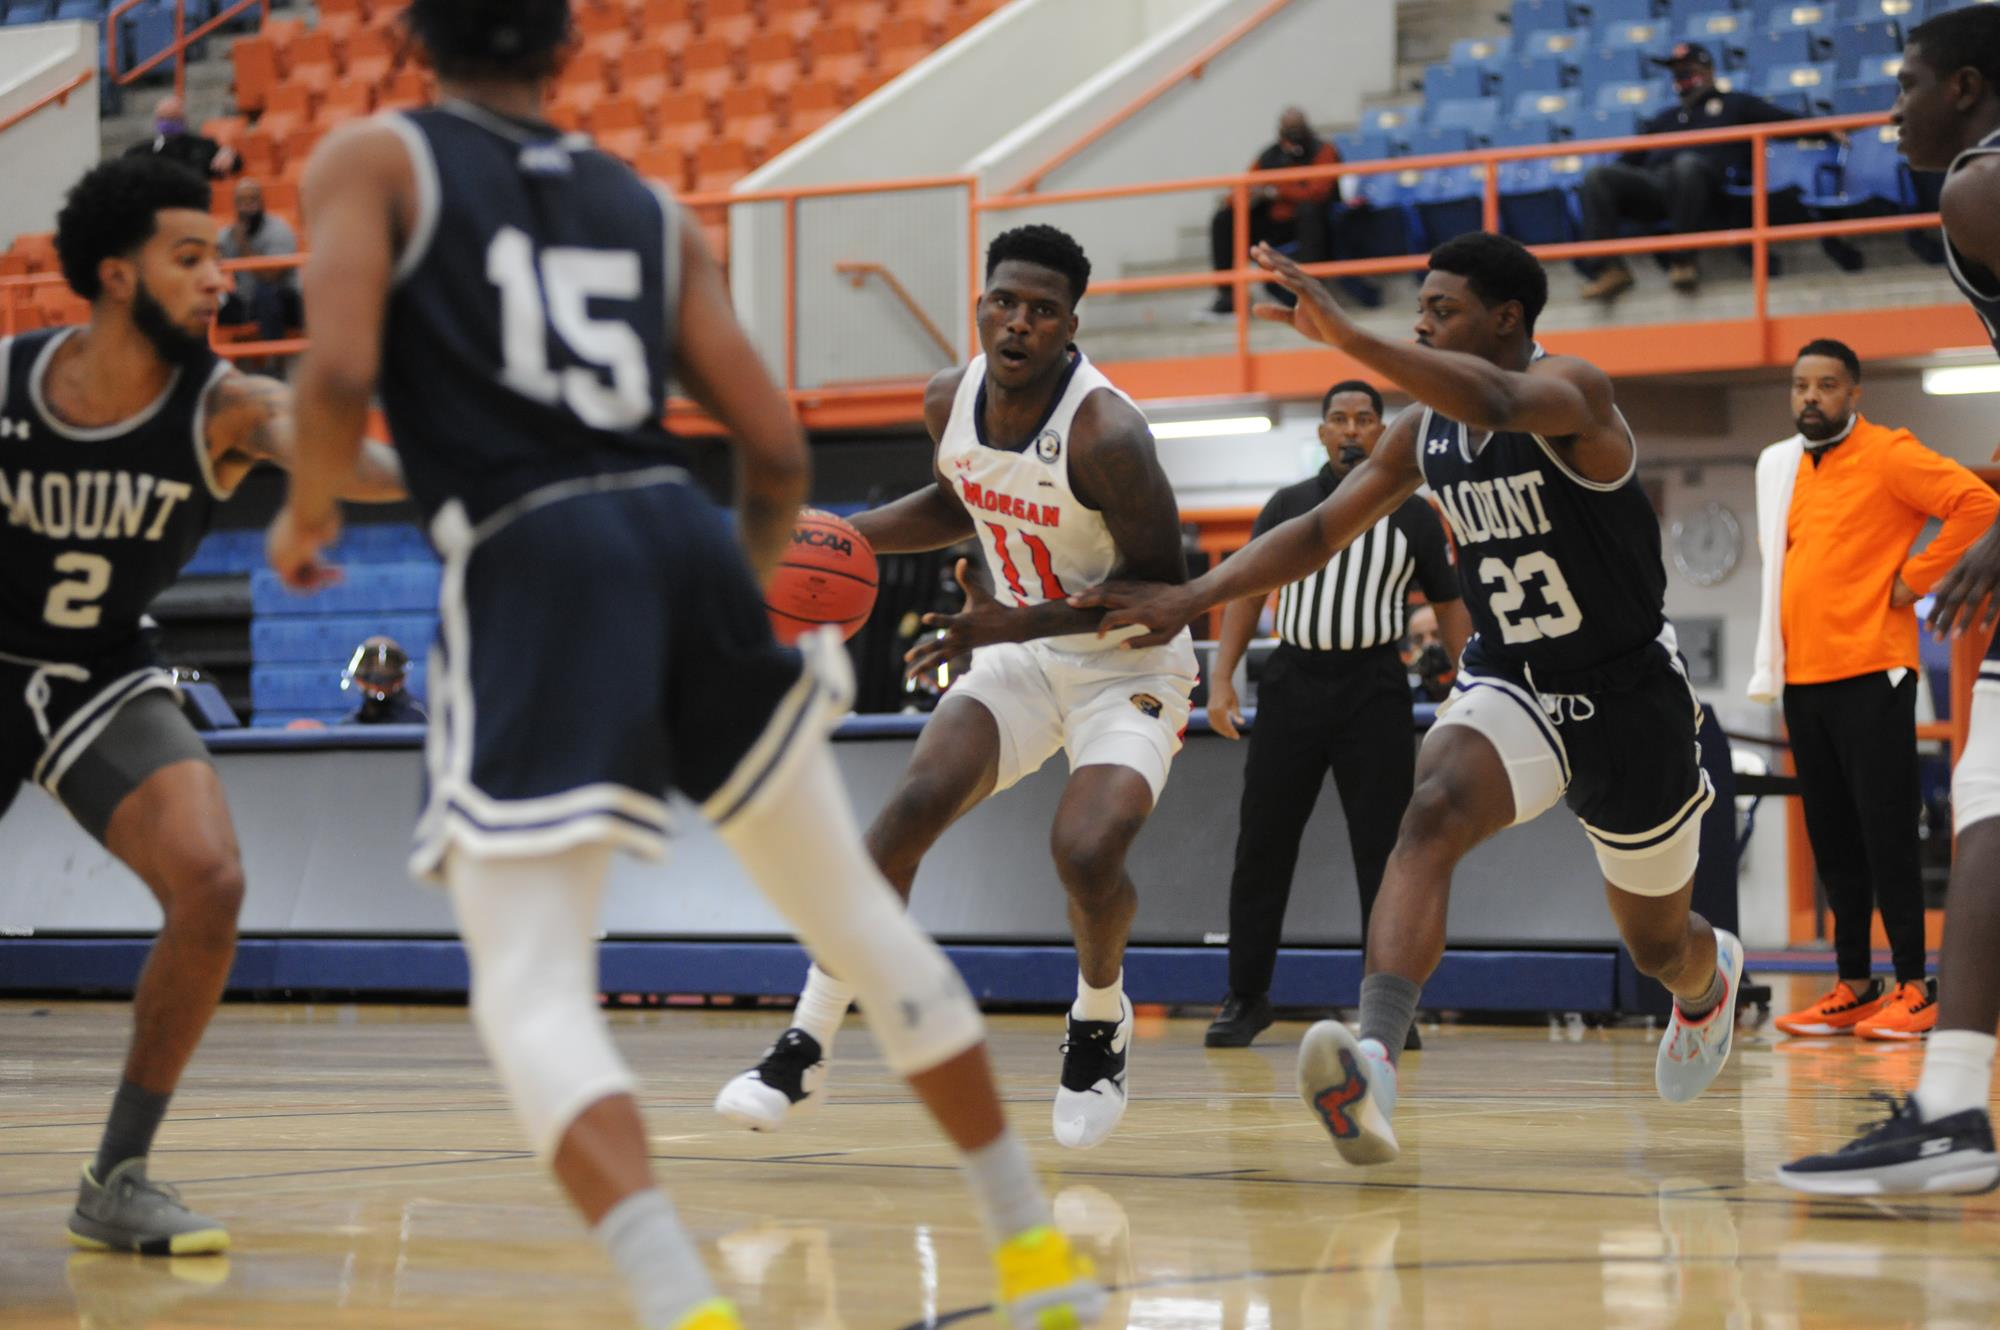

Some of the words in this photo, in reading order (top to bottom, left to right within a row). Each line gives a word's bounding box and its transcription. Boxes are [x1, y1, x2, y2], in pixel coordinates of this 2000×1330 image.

[486, 225, 653, 431] 15
[0, 467, 192, 541] MOUNT
[960, 475, 1060, 527] MORGAN
[1432, 470, 1552, 546] MOUNT
[43, 551, 112, 628] 2
[983, 519, 1072, 608] 11
[1478, 551, 1583, 645] 23
